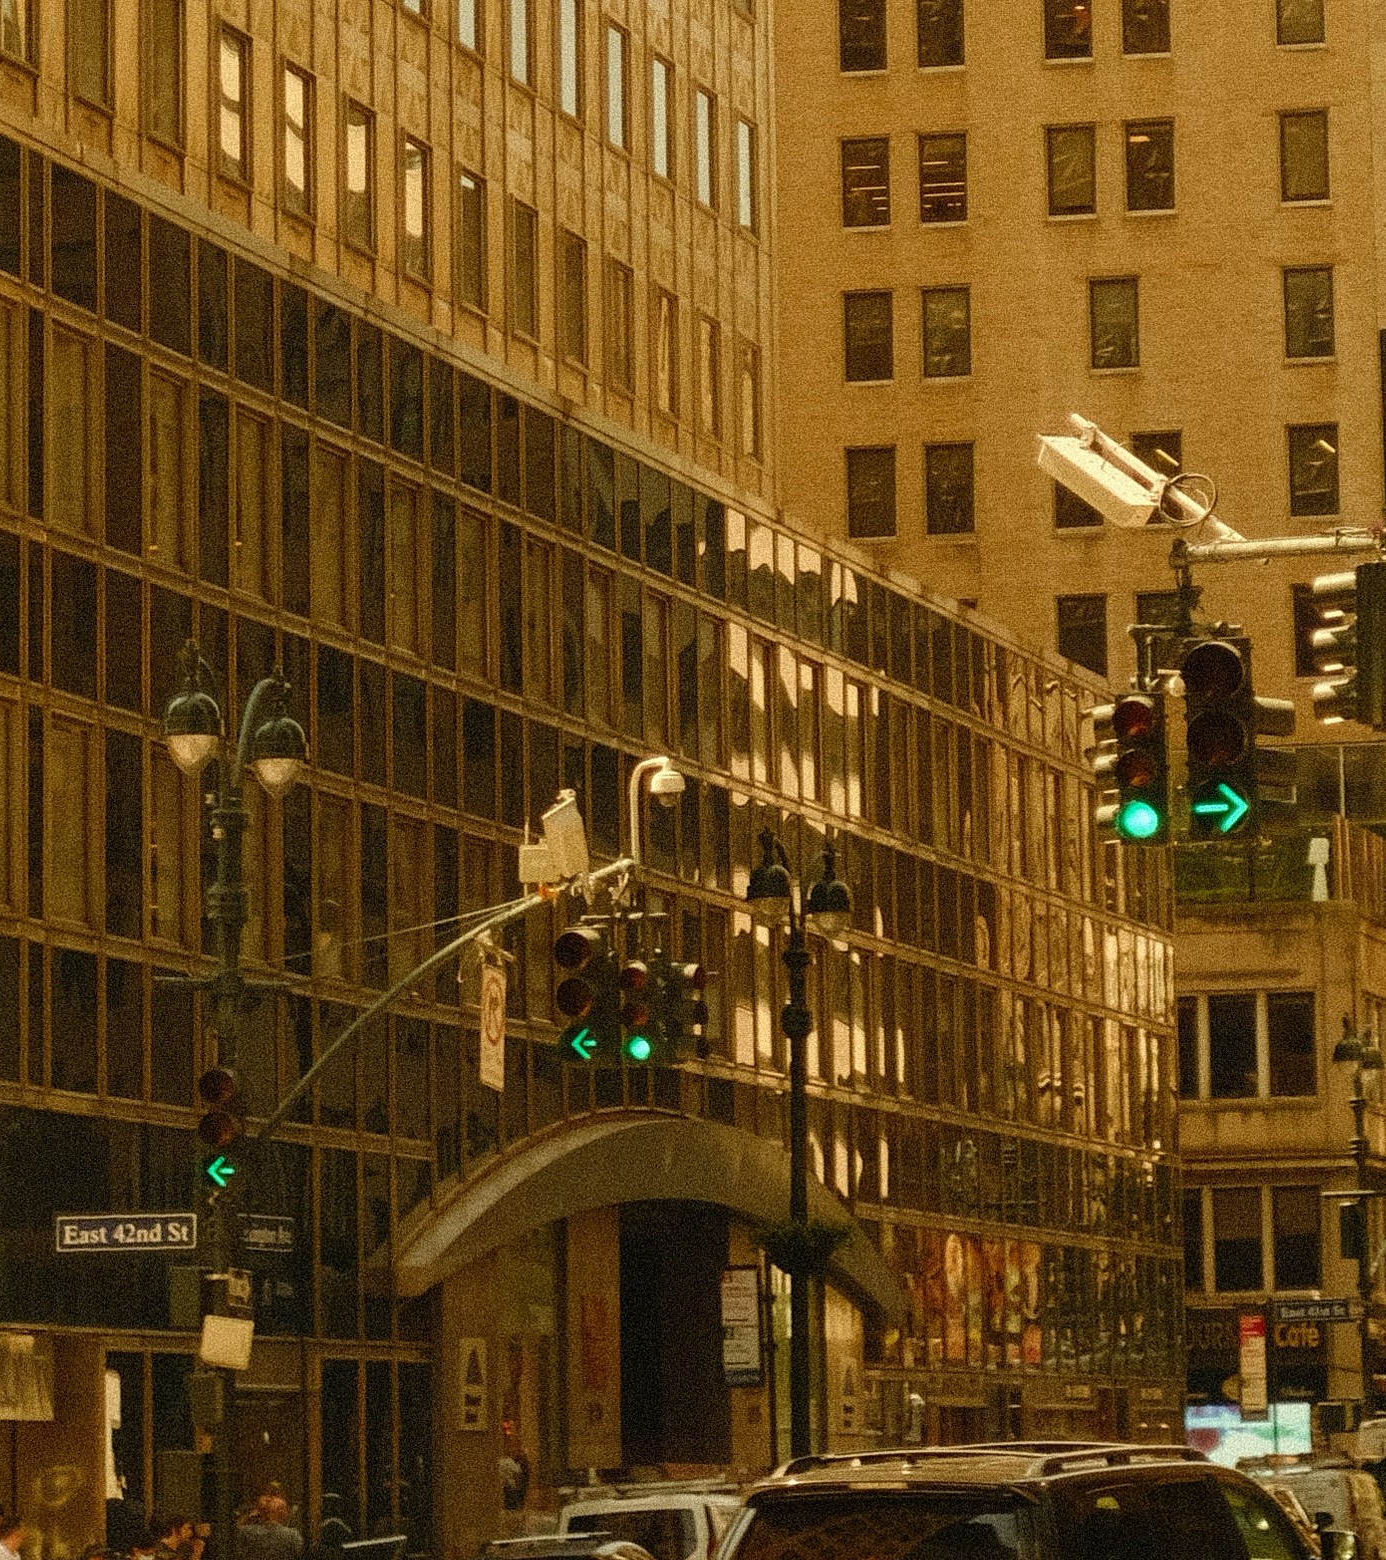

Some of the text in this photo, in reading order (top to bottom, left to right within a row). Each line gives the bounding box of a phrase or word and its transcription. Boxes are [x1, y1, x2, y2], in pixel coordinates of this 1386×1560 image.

[63, 1222, 189, 1245] East 42nd St
